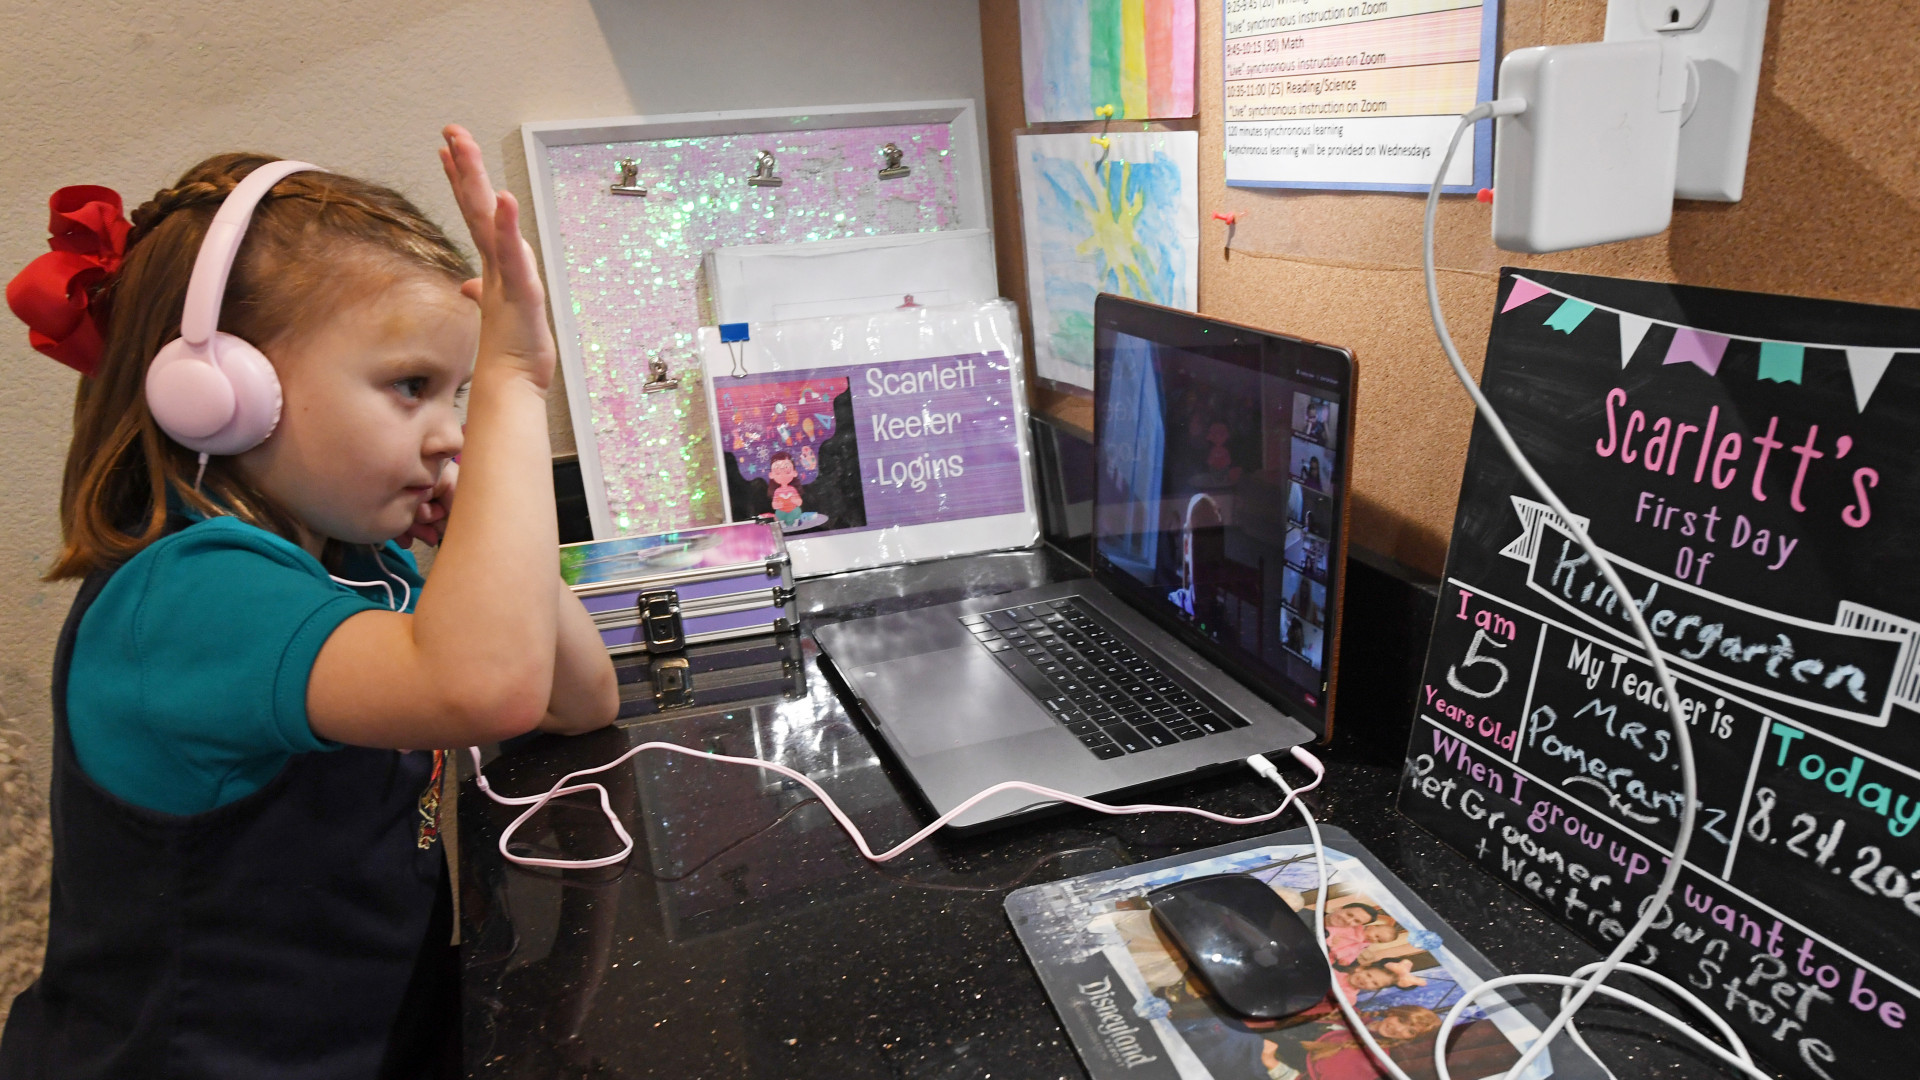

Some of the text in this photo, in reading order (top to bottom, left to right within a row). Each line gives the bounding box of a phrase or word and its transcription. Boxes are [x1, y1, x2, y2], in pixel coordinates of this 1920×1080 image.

[1247, 14, 1296, 33] synchronous
[1299, 6, 1345, 24] instruction
[1347, 5, 1359, 18] on
[1361, 1, 1388, 16] Zoom
[1247, 59, 1296, 78] synchronous
[1298, 53, 1345, 71] instruction
[1346, 54, 1358, 66] on
[1360, 51, 1386, 66] Zoom
[1263, 38, 1279, 54] (30)
[1281, 35, 1304, 50] Math
[1227, 77, 1357, 98] 10:35-11:00 (25) Reading/Science
[1248, 103, 1297, 119] synchronous
[1299, 100, 1345, 115] instruction
[1347, 101, 1359, 113] on
[1361, 99, 1387, 113] Zoom
[1228, 143, 1431, 160] Asynchronous learning will be provided on Wednesdays
[1239, 125, 1262, 137] minutes
[1264, 124, 1311, 139] synchronous
[1313, 122, 1344, 138] learning
[865, 360, 976, 397] Scarlett
[871, 407, 962, 442] Keeler
[877, 453, 964, 493] Logins
[1595, 387, 1879, 528] Scarlett's
[1635, 491, 1798, 570] First Day
[1675, 546, 1715, 585] Of
[1456, 589, 1516, 641] I am
[1446, 628, 1509, 699] 5
[1567, 638, 1605, 690] My
[1710, 698, 1735, 739] is
[1425, 685, 1518, 751] Years Old
[1771, 722, 1920, 837] Today
[1411, 754, 1457, 809] Pet
[1745, 953, 1834, 1022] Pet
[1433, 729, 1503, 794] When
[1510, 772, 1528, 805] I
[1527, 800, 1604, 849] grow
[1609, 841, 1650, 884] up
[1684, 884, 1784, 958] want
[1797, 938, 1840, 988] to
[1849, 967, 1906, 1029] be
[1077, 975, 1157, 1069] Disneyland
[1688, 958, 1835, 1080] Store
